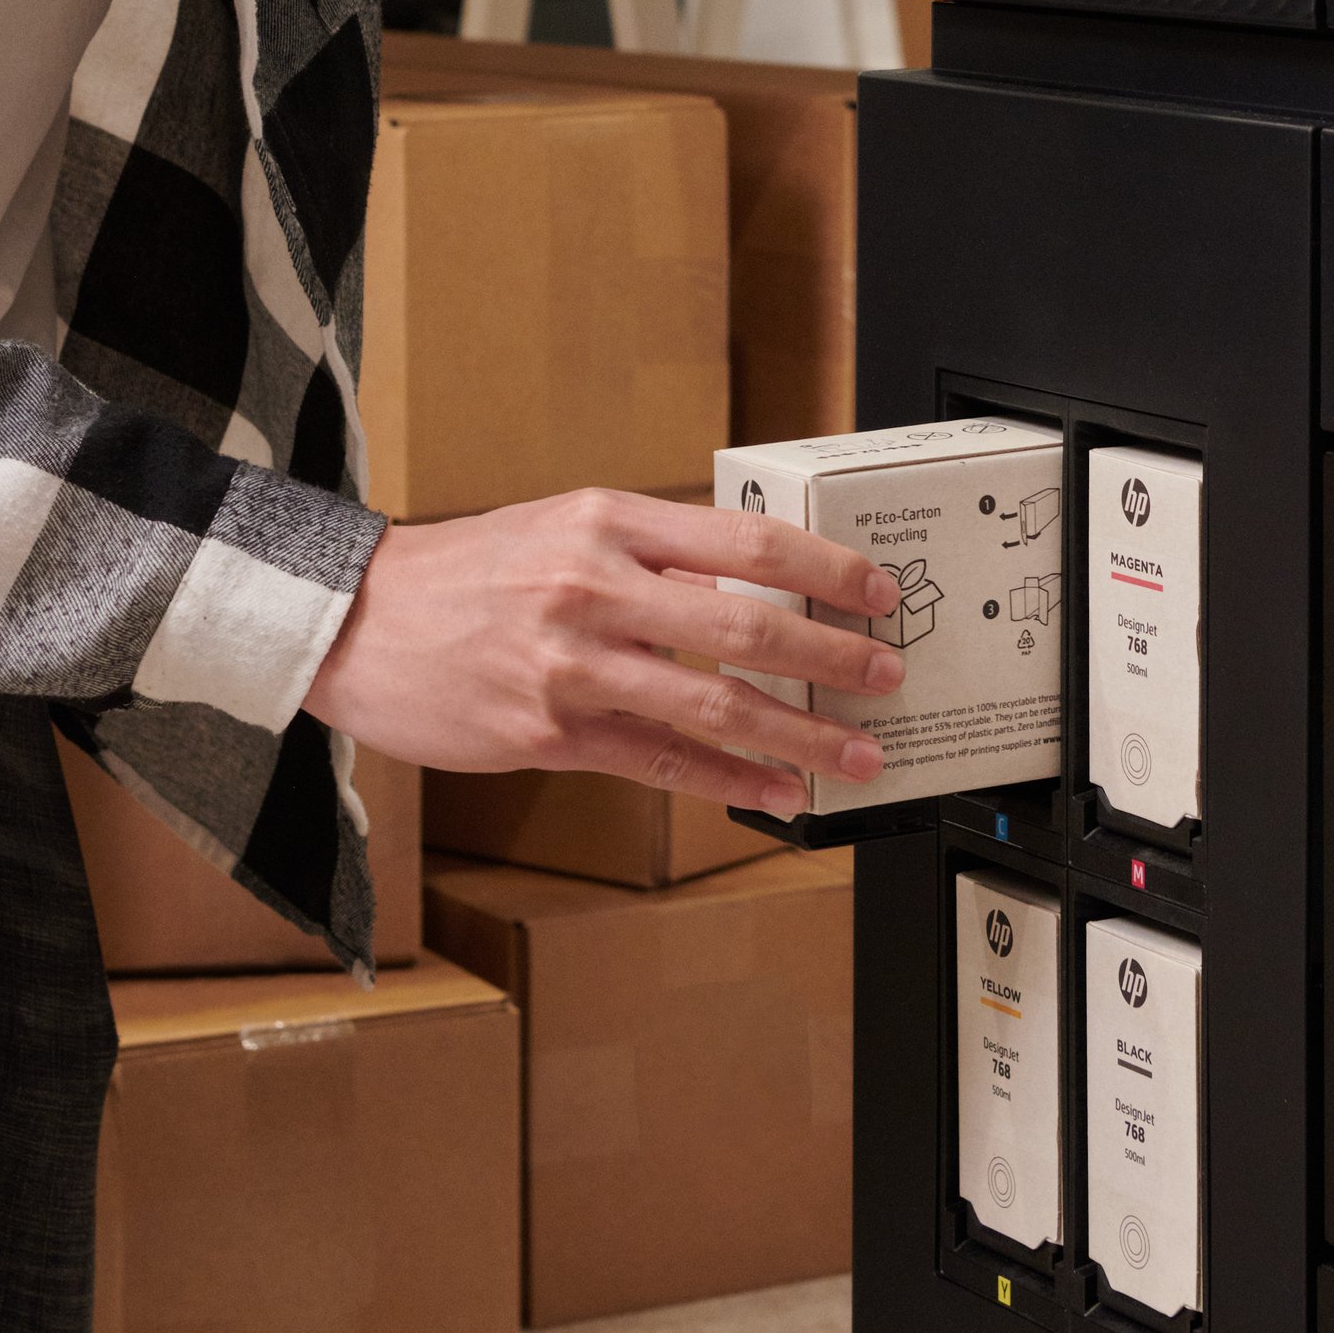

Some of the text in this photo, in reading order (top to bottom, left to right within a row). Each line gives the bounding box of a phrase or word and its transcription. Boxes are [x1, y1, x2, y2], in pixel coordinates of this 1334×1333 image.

[1122, 478, 1150, 527] hp
[856, 507, 941, 527] HP Eco-Carton
[871, 528, 927, 545] Recycling
[1110, 552, 1163, 578] MAGENTA
[1117, 614, 1157, 637] DesignJet
[1127, 636, 1147, 656] 768
[1127, 662, 1148, 678] 500ml
[860, 720, 872, 729] HP
[873, 715, 918, 728] Eco-Carton:
[920, 712, 940, 721] outer
[942, 708, 966, 717] carton
[968, 705, 974, 714] is
[977, 702, 997, 712] 100%
[999, 697, 1036, 709] recyclable
[882, 727, 919, 739] materials
[935, 722, 952, 731] 55%
[953, 716, 993, 728] recyclable.
[995, 714, 1013, 722] They
[896, 741, 907, 750] for
[908, 734, 957, 748] reprocessing
[959, 731, 966, 740] of
[968, 728, 992, 740] plastic
[994, 726, 1016, 736] parts.
[1017, 723, 1034, 731] Zero
[883, 758, 914, 770] ecycling
[916, 754, 944, 765] options
[946, 750, 956, 759] for
[958, 748, 969, 757] HP
[970, 744, 999, 757] printing
[1001, 740, 1032, 751] supplies
[987, 909, 1013, 957] hp
[980, 976, 1021, 1004] YELLOW
[1118, 958, 1147, 1008] hp
[984, 1036, 1019, 1063] DesignJet
[1117, 1039, 1152, 1065] BLACK
[992, 1058, 1011, 1080] 768
[992, 1084, 1011, 1102] 500ml
[1116, 1098, 1154, 1127] DesignJet
[1125, 1121, 1145, 1143] 768
[1125, 1147, 1145, 1166] 500ml
